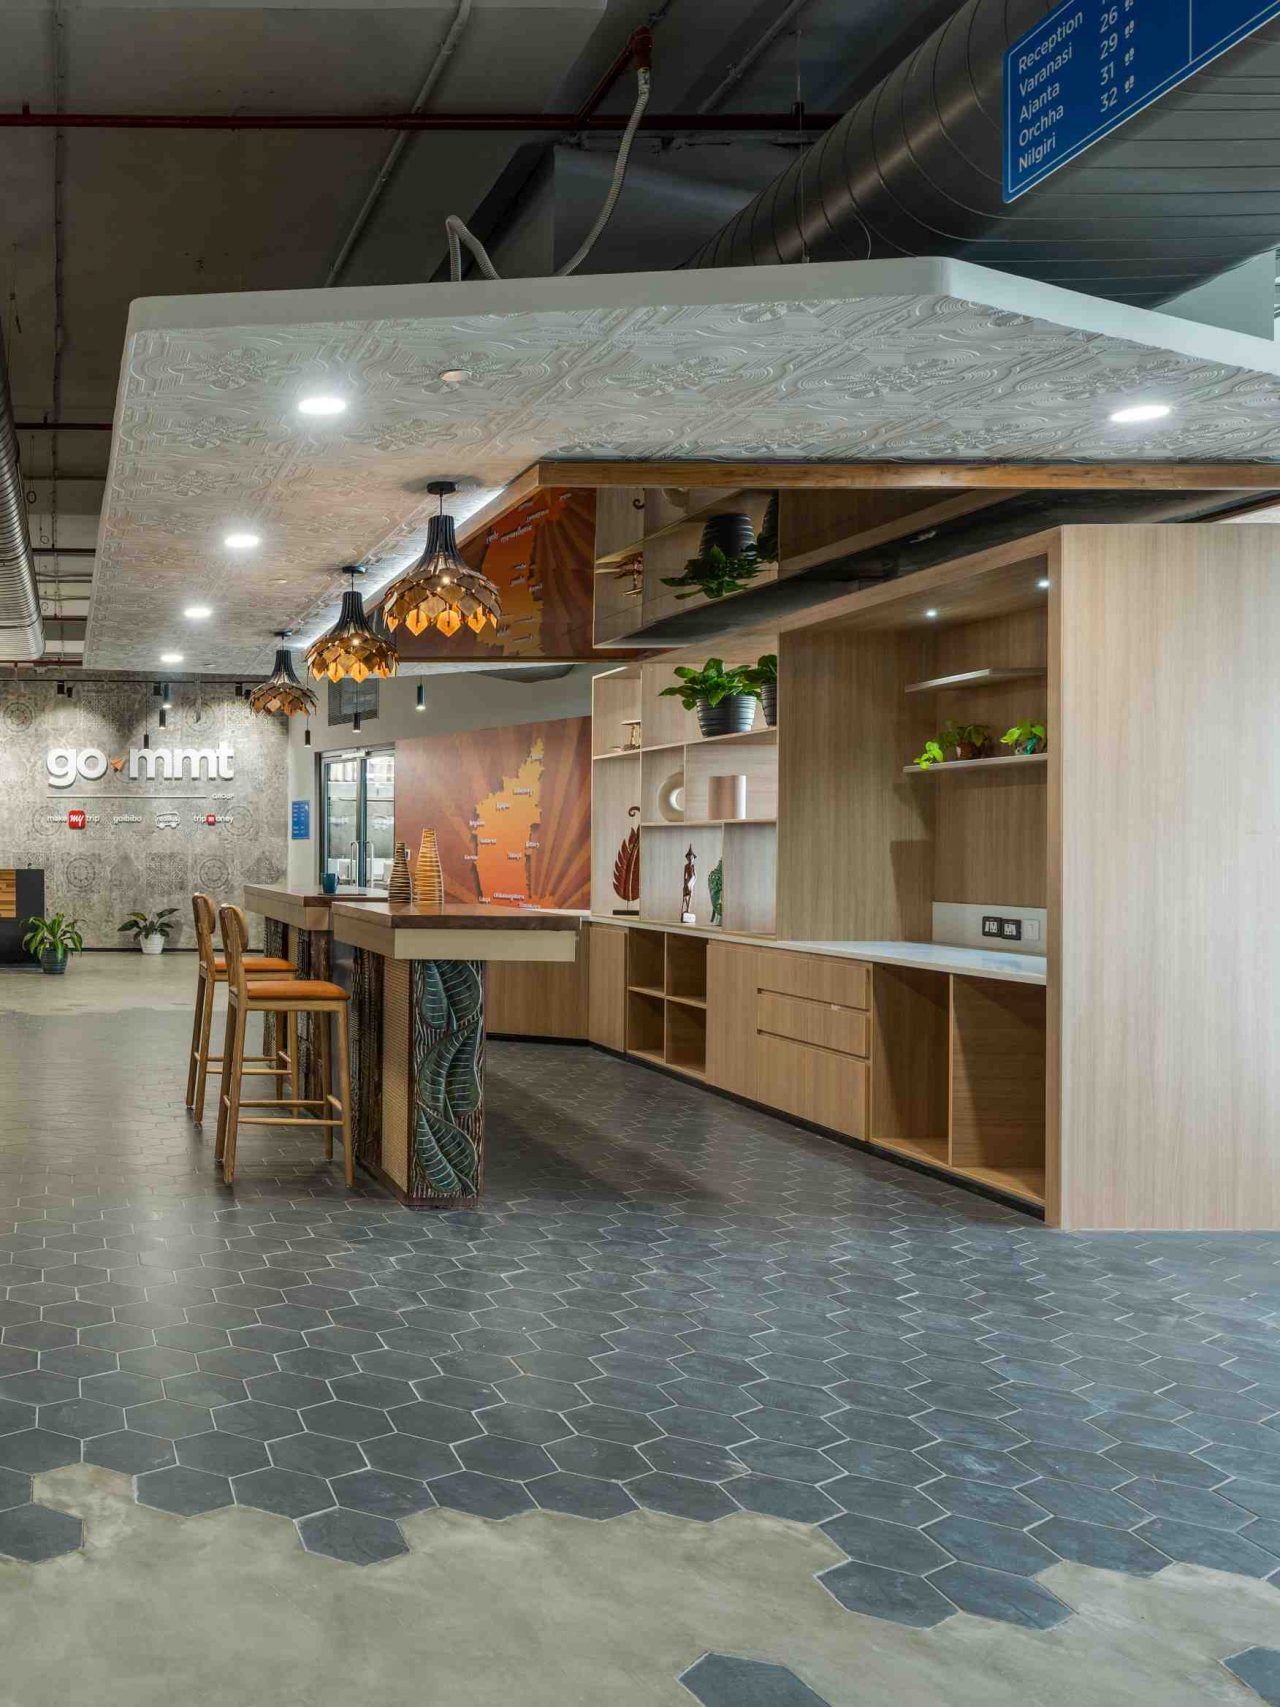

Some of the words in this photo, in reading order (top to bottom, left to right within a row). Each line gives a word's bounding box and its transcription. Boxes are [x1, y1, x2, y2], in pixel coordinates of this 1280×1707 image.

[1018, 11, 1083, 75] Reception
[1019, 42, 1073, 97] Varanasi
[1100, 5, 1118, 33] 26
[1019, 82, 1061, 123] Ajanta
[1100, 33, 1118, 60] 29
[1018, 131, 1056, 173] Nilgiri
[1100, 87, 1118, 112] 32
[1019, 105, 1064, 147] Orchha
[1100, 61, 1115, 85] 31
[47, 748, 108, 787] go
[129, 741, 235, 779] mmt
